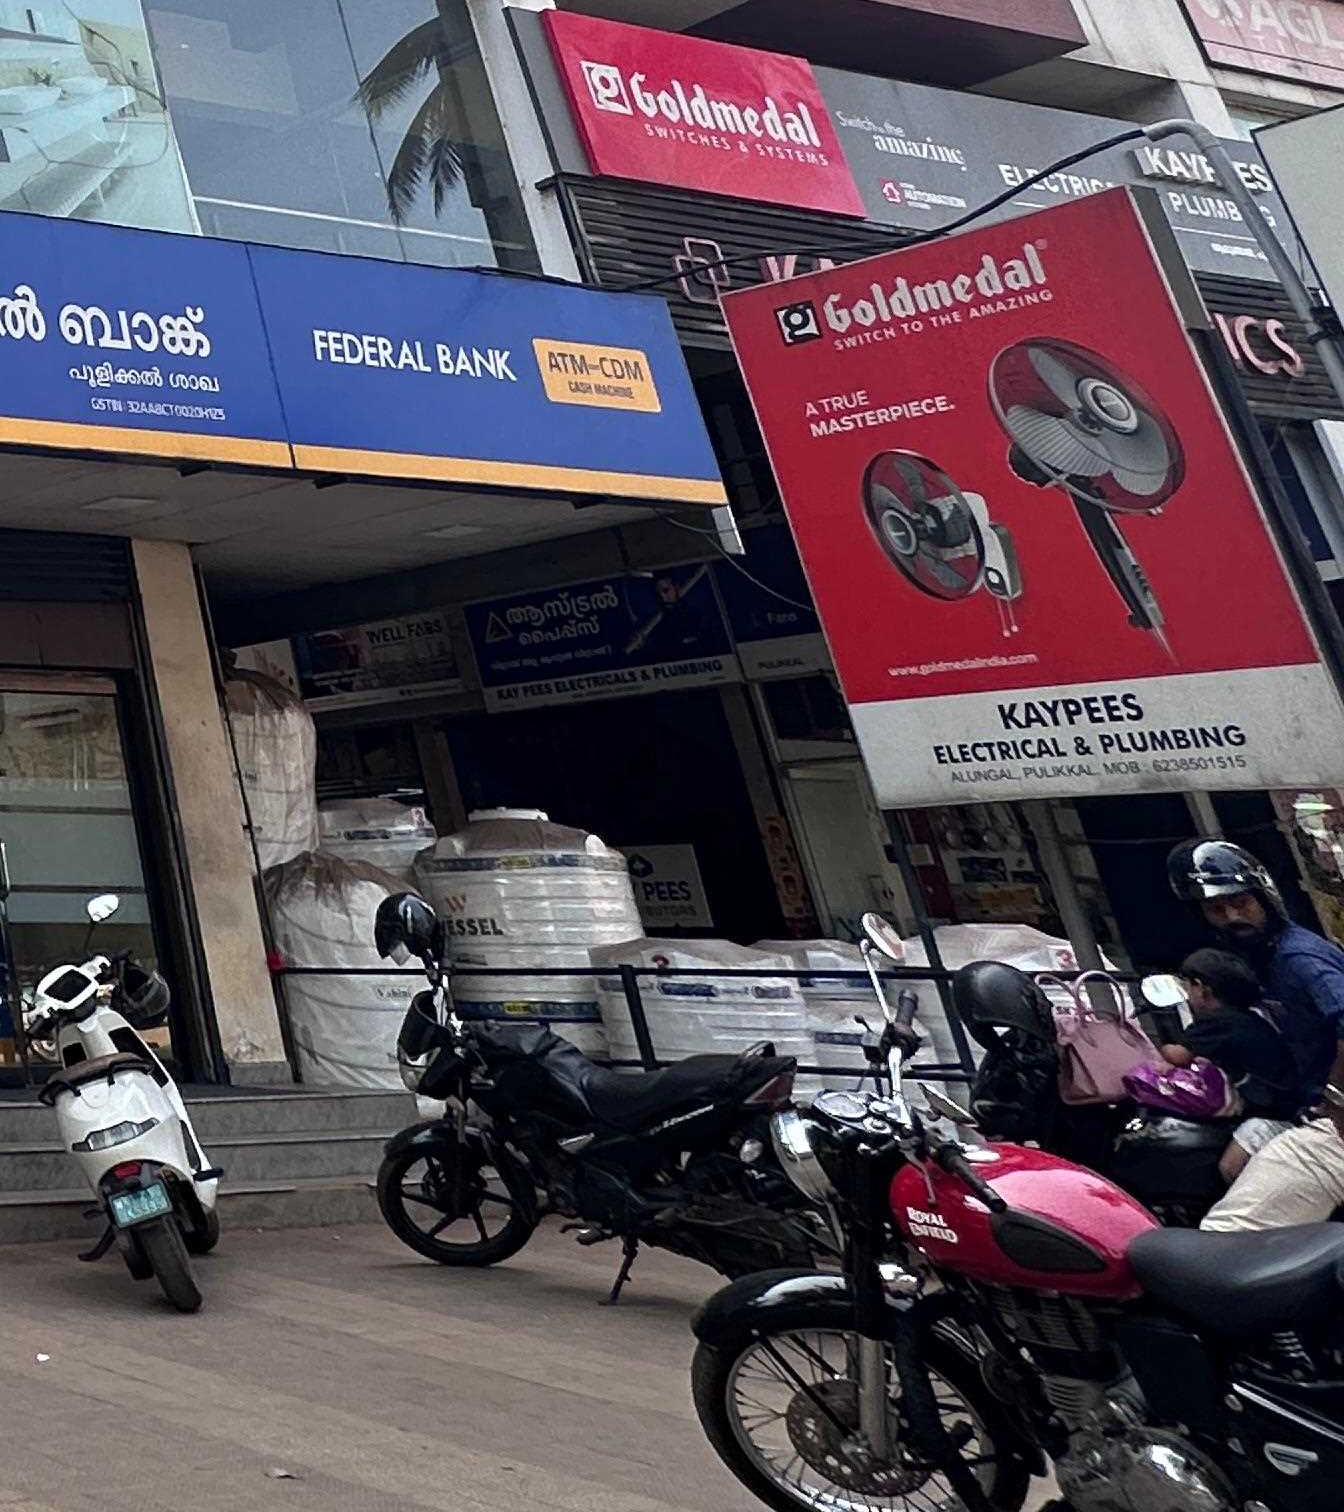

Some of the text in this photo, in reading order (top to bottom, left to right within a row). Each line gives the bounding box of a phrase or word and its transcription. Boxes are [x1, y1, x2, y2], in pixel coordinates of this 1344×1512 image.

[630, 71, 822, 148] Goldmedal
[643, 123, 731, 150] SWITCHES
[756, 144, 829, 166] SYSTEMS
[872, 136, 967, 171] amazing
[1169, 192, 1276, 228] PLUMBG
[822, 242, 1047, 333] Goldmedal
[58, 304, 212, 358] ബാങ്ക്
[832, 289, 1053, 351] SWITCH TO THE AMAZING
[313, 329, 518, 381] FEDERAL BANK
[169, 372, 220, 393] ശാഖ
[804, 390, 870, 418] A TRUE
[810, 395, 956, 438] MASTERPIECE.
[654, 659, 724, 680] PLUMBING
[997, 693, 1144, 730] KAYPEES
[933, 724, 1247, 765] ELECTRICAL & PLUMBING
[642, 880, 692, 902] PEES
[440, 917, 505, 937] ESSEL
